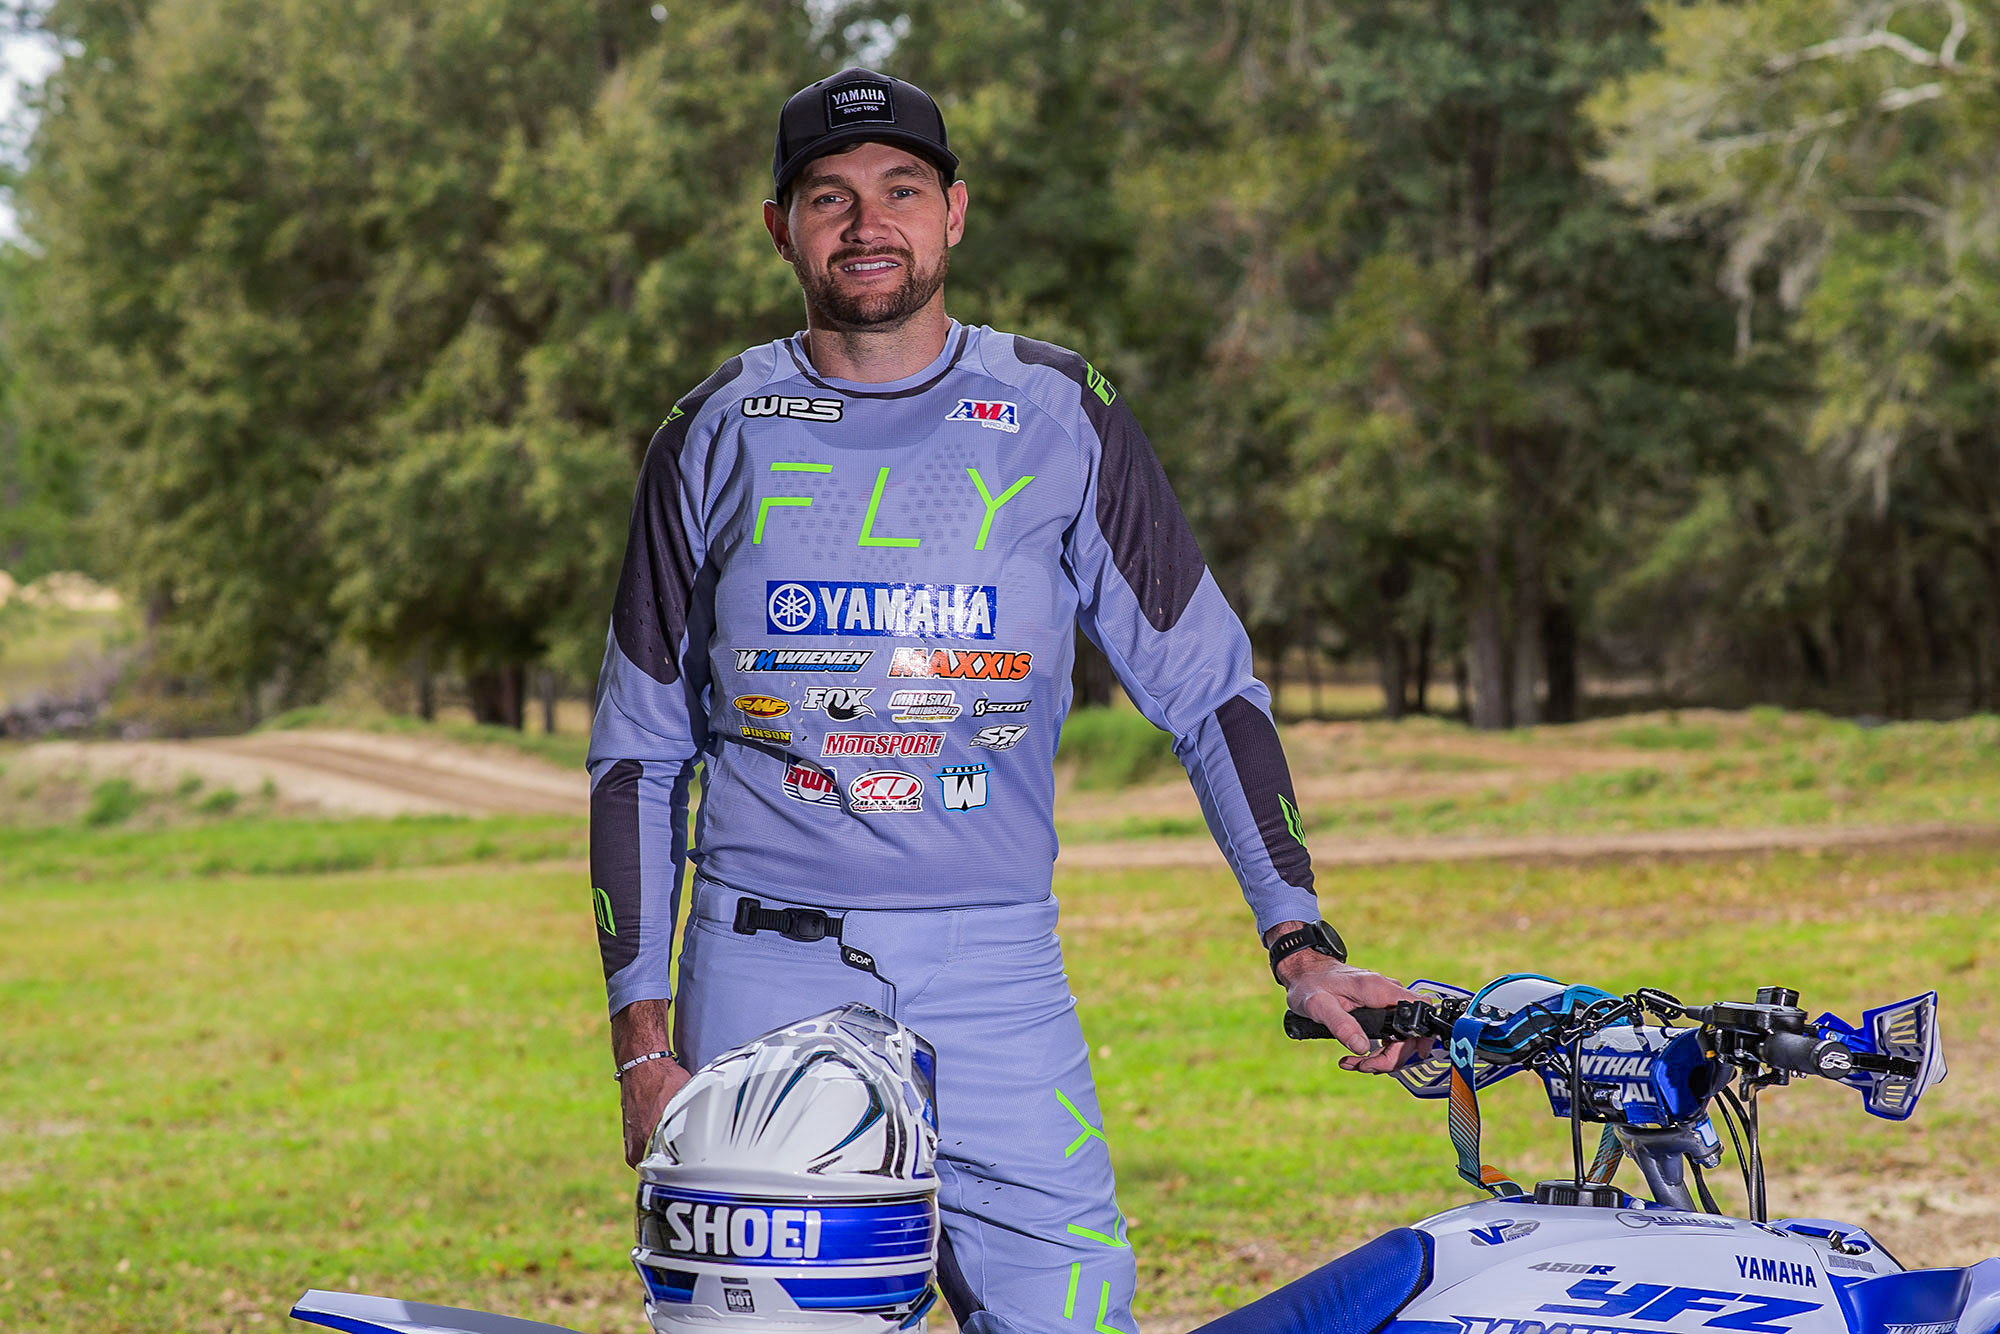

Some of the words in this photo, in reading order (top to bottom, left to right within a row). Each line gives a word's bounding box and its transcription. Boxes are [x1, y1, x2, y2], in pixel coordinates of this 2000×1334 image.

[832, 88, 886, 105] YAMAHA
[843, 106, 862, 115] Since
[951, 401, 1015, 425] AMA
[753, 462, 1036, 551] FLY
[819, 587, 991, 634] YAMAHA
[774, 651, 871, 665] WIENEN
[889, 649, 1032, 680] MAXXIS
[775, 663, 861, 672] MOTORSPORTS
[739, 698, 788, 713] FMF
[803, 687, 872, 711] FOX
[892, 693, 952, 706] MALASKA
[985, 701, 1031, 713] SCOTT
[741, 726, 792, 741] HINSON
[665, 1202, 822, 1259] SHOEI
[1468, 1218, 1516, 1246] VP
[1528, 1262, 1616, 1275] 450R
[1735, 1255, 1817, 1288] YAMAHA
[727, 1294, 751, 1307] DOT
[1534, 1279, 1824, 1334] YFZ
